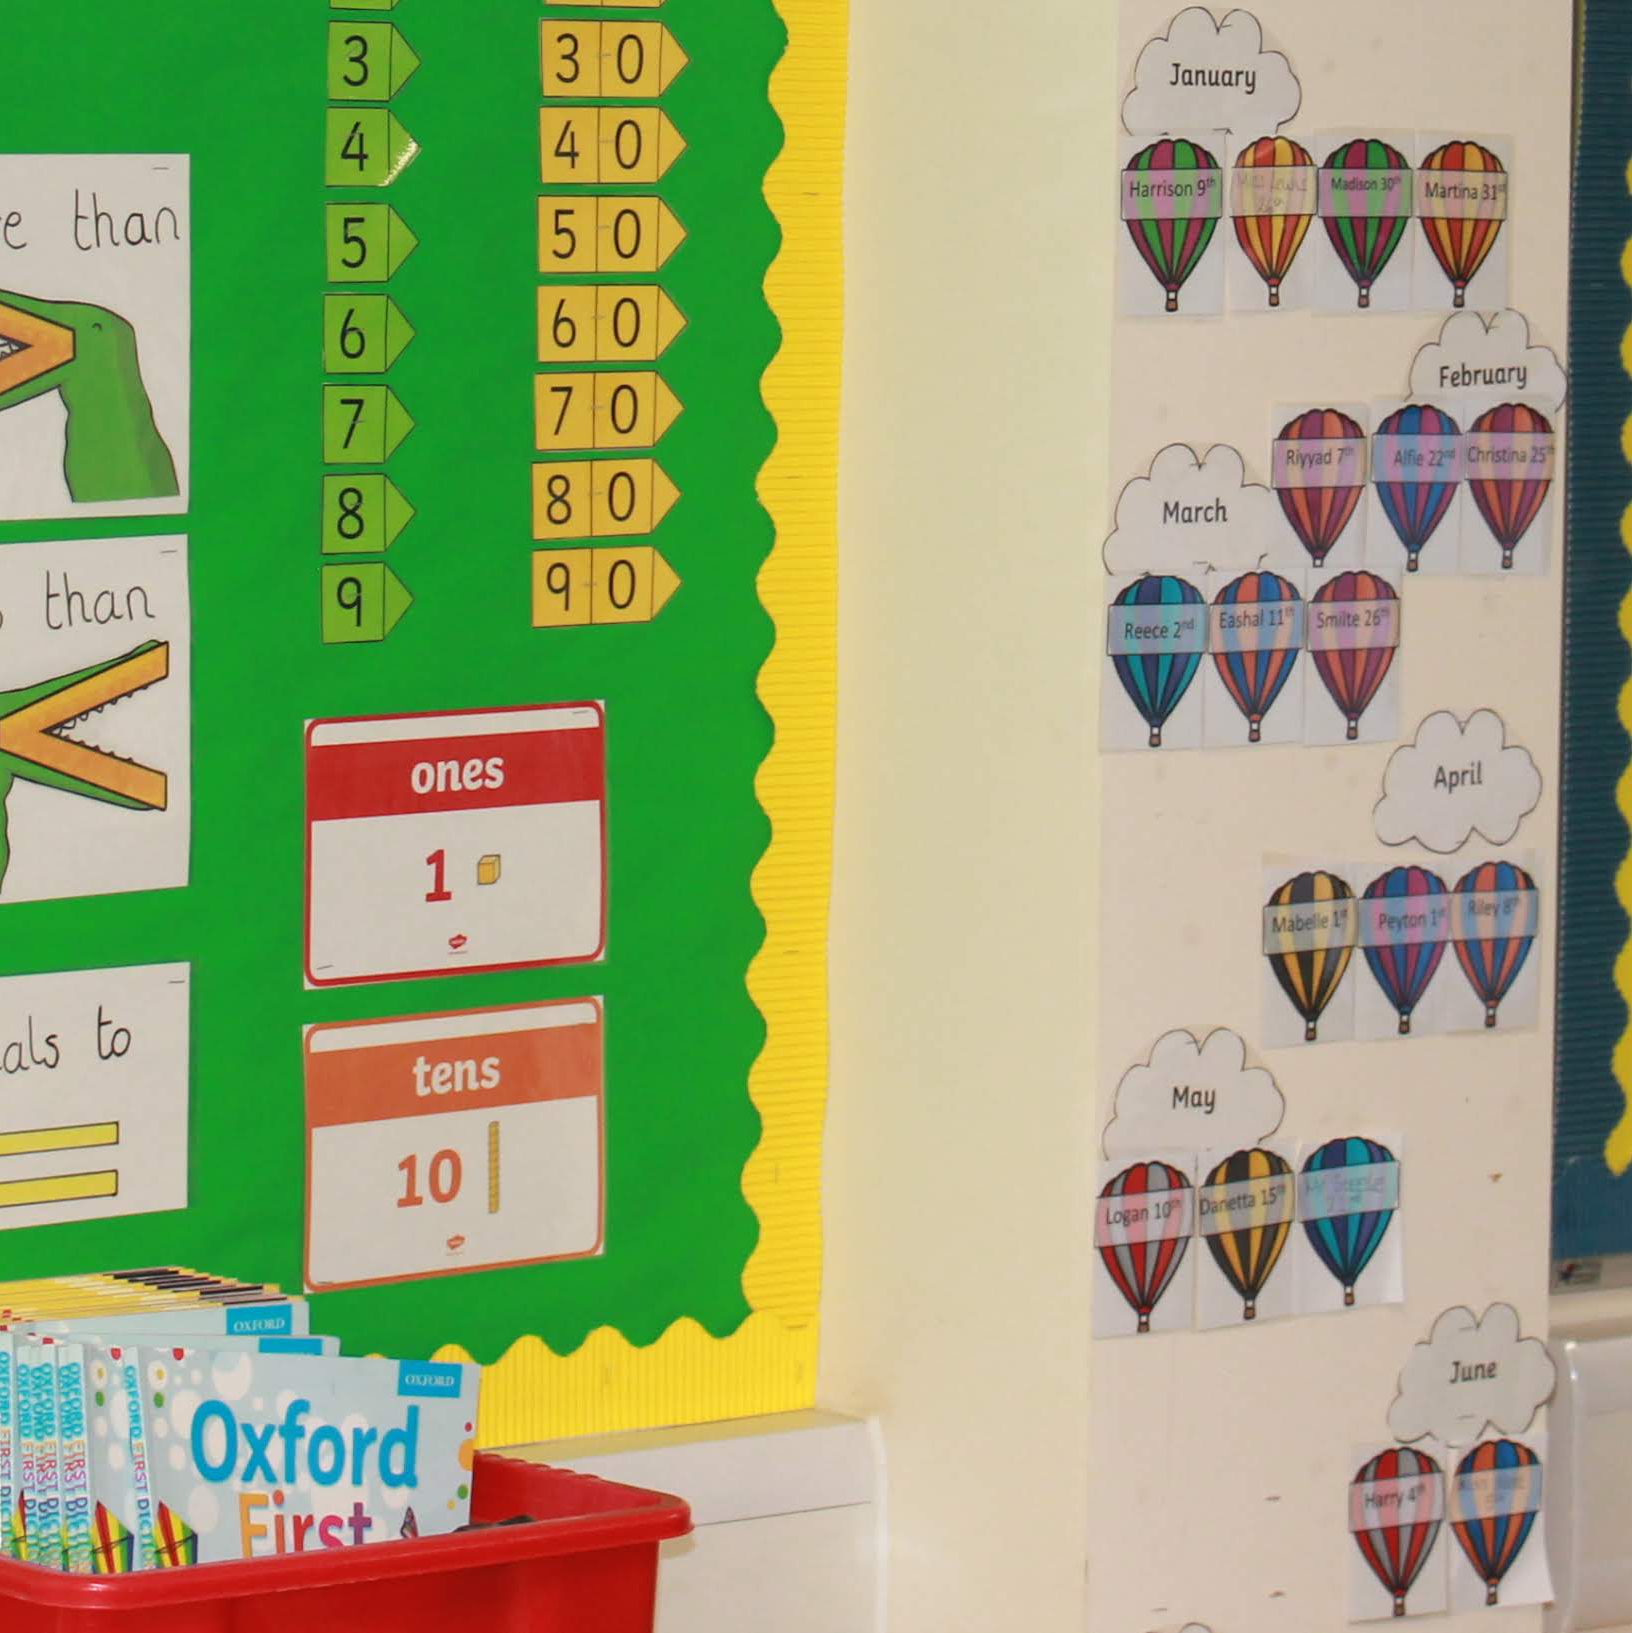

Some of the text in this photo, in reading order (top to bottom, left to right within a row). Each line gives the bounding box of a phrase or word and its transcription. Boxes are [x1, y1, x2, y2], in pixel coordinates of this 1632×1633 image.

[342, 35, 368, 87] 3
[1170, 63, 1256, 95] January
[340, 121, 368, 171] 4
[1130, 180, 1193, 198] Harrison
[1331, 177, 1377, 191] Madison
[1425, 182, 1478, 199] Martina
[73, 188, 180, 250] than
[341, 217, 367, 269] 5
[340, 308, 365, 359] 6
[1439, 364, 1528, 391] February
[340, 399, 364, 449] 7
[1393, 450, 1424, 467] Alfie
[1468, 446, 1527, 463] Christina
[337, 487, 364, 539] 8
[1163, 501, 1228, 525] March
[44, 570, 156, 630] than
[337, 577, 362, 627] 9
[1124, 623, 1168, 639] Reece
[410, 753, 505, 795] ones
[1434, 761, 1483, 794] April
[424, 849, 452, 903] 1
[97, 1004, 132, 1058] to
[413, 1054, 501, 1097] tens
[1172, 1086, 1216, 1114] May
[396, 1148, 463, 1208] 10
[1106, 1203, 1149, 1227] Logan
[233, 1317, 285, 1333] OXFORD
[405, 1374, 455, 1387] OXFORD
[1449, 1360, 1497, 1384] June
[125, 1365, 142, 1439] OXFORD
[190, 1398, 420, 1489] Oxford
[133, 1442, 148, 1492] FIRST
[238, 1489, 373, 1559] First
